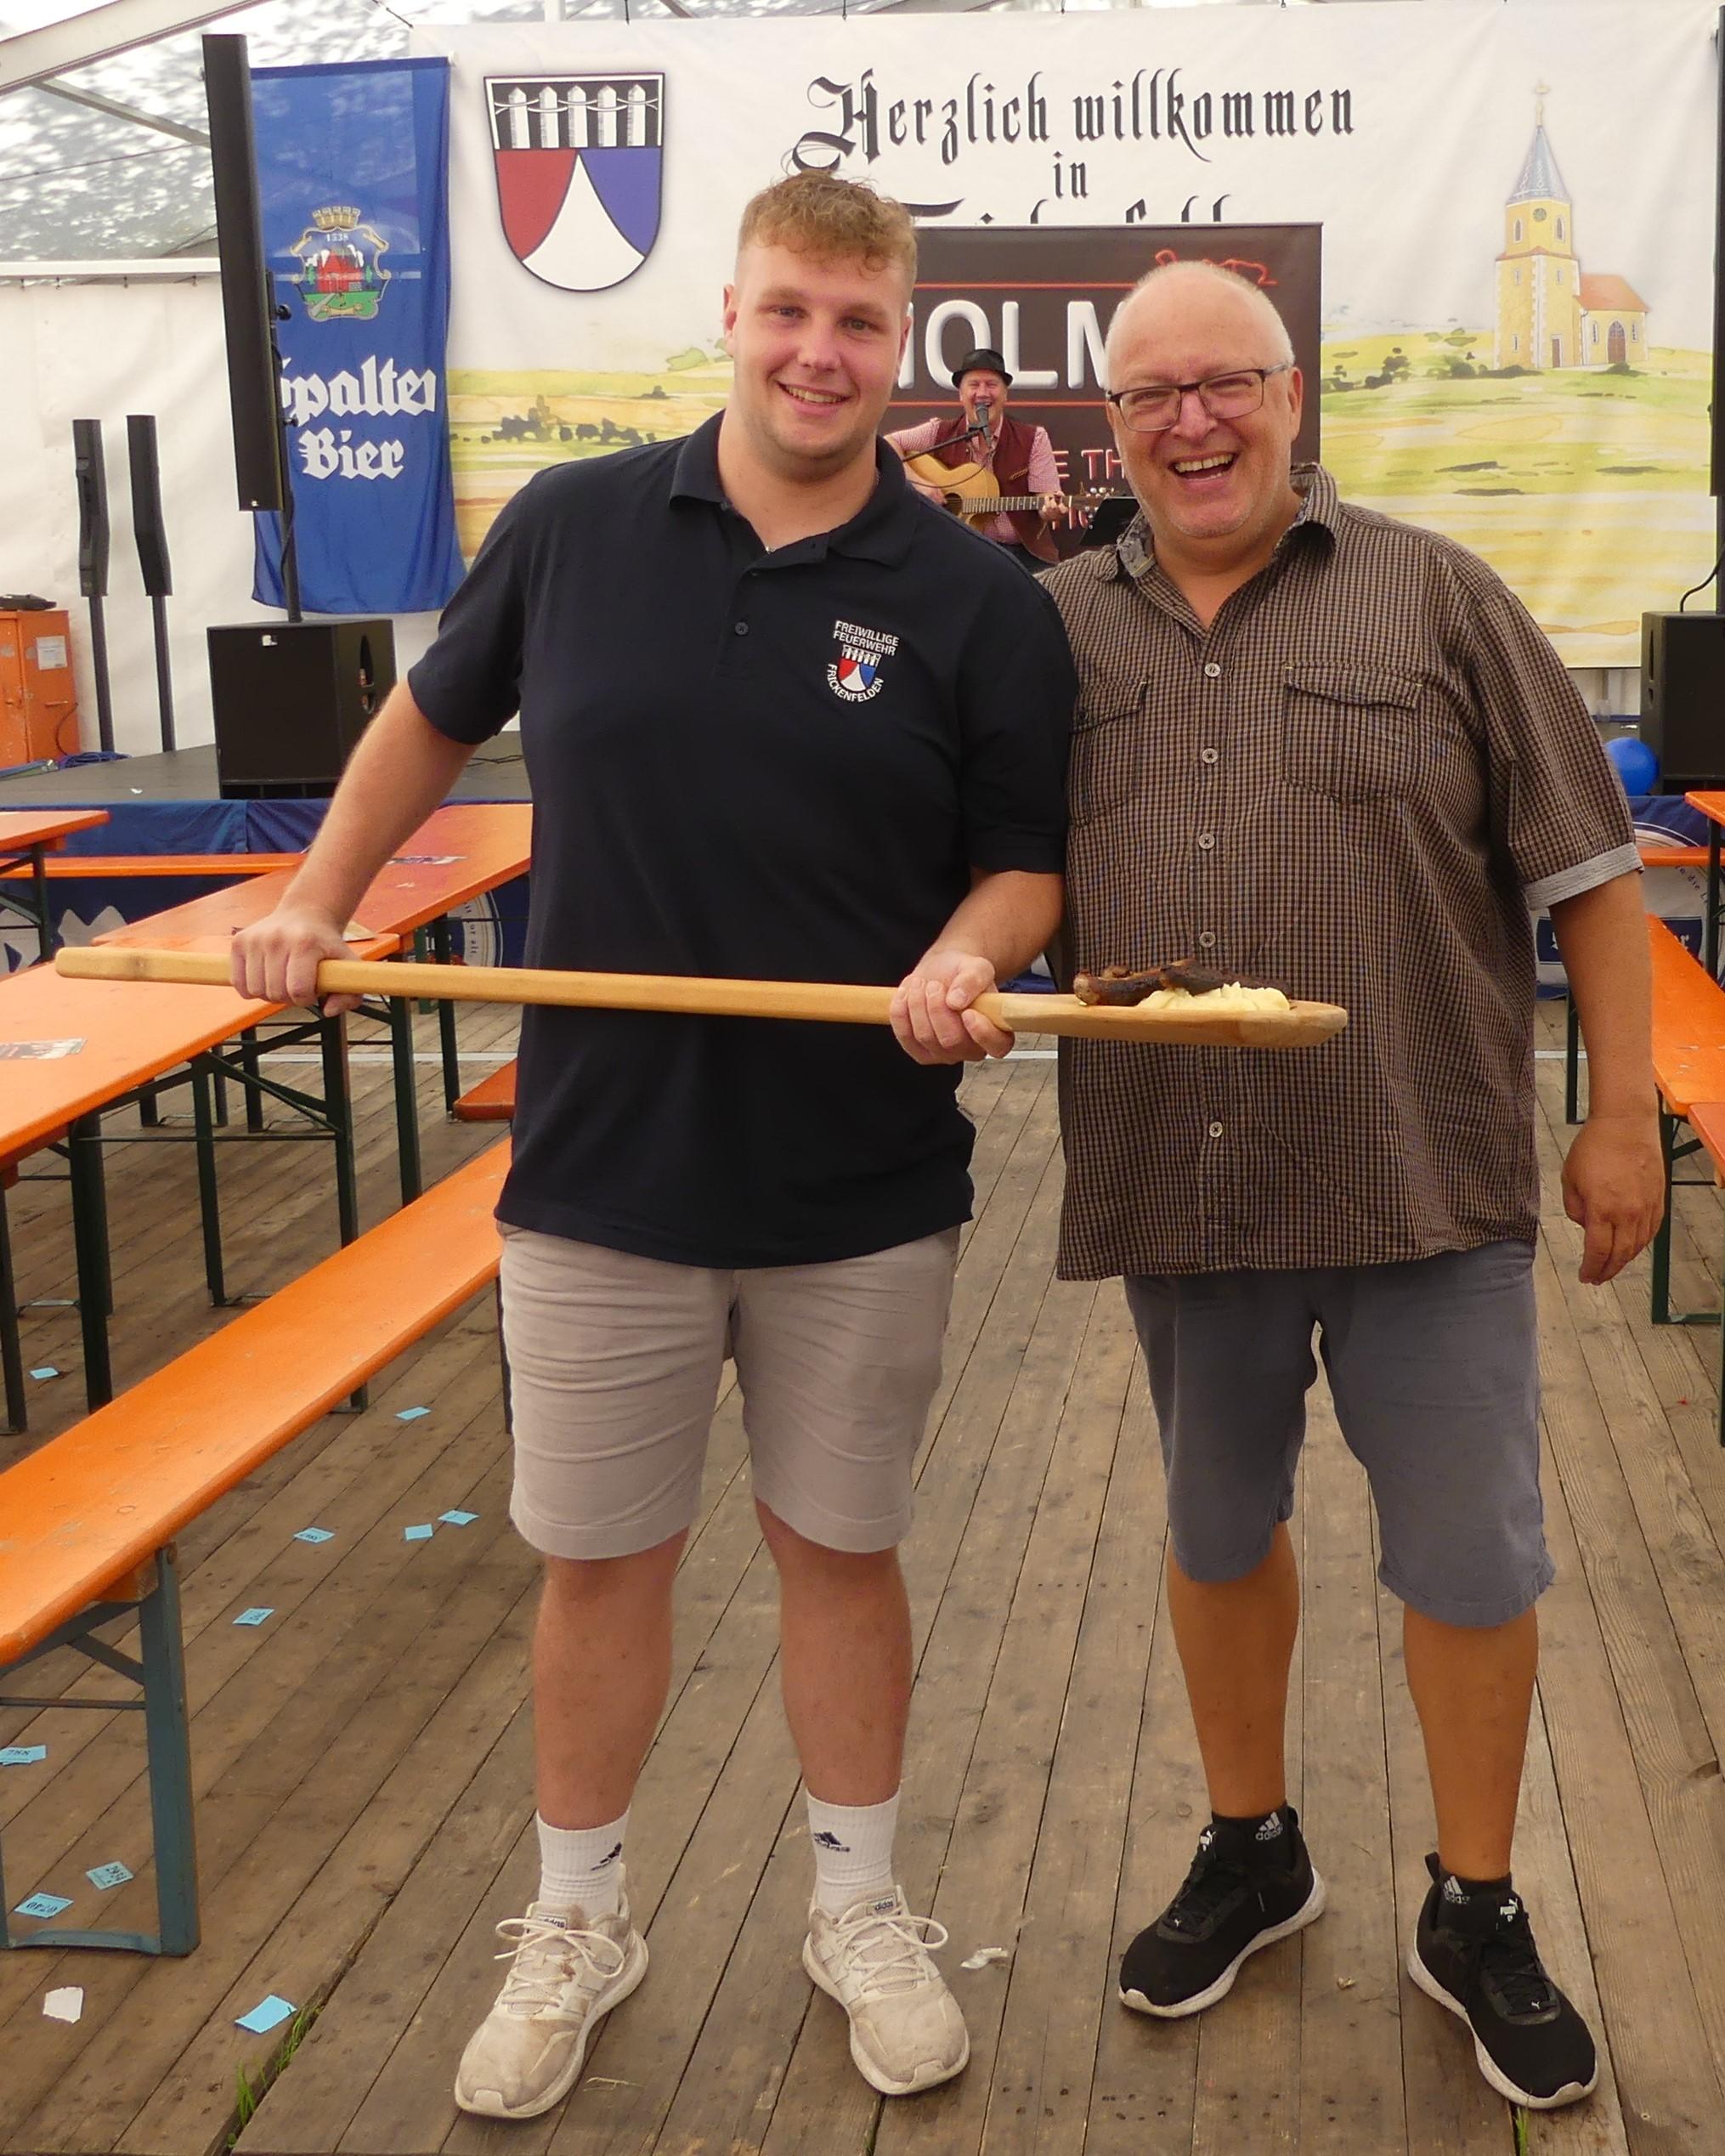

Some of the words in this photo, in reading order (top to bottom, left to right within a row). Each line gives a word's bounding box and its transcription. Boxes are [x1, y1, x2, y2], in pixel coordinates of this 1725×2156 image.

[782, 68, 1050, 173] Herzlich
[1072, 68, 1355, 163] willkommen
[1054, 151, 1089, 199] in
[298, 427, 404, 480] Bier
[833, 630, 896, 656] FEUERWEHR
[834, 620, 900, 647] FREIWILLIGE
[827, 663, 885, 703] FRICKENFELDEN
